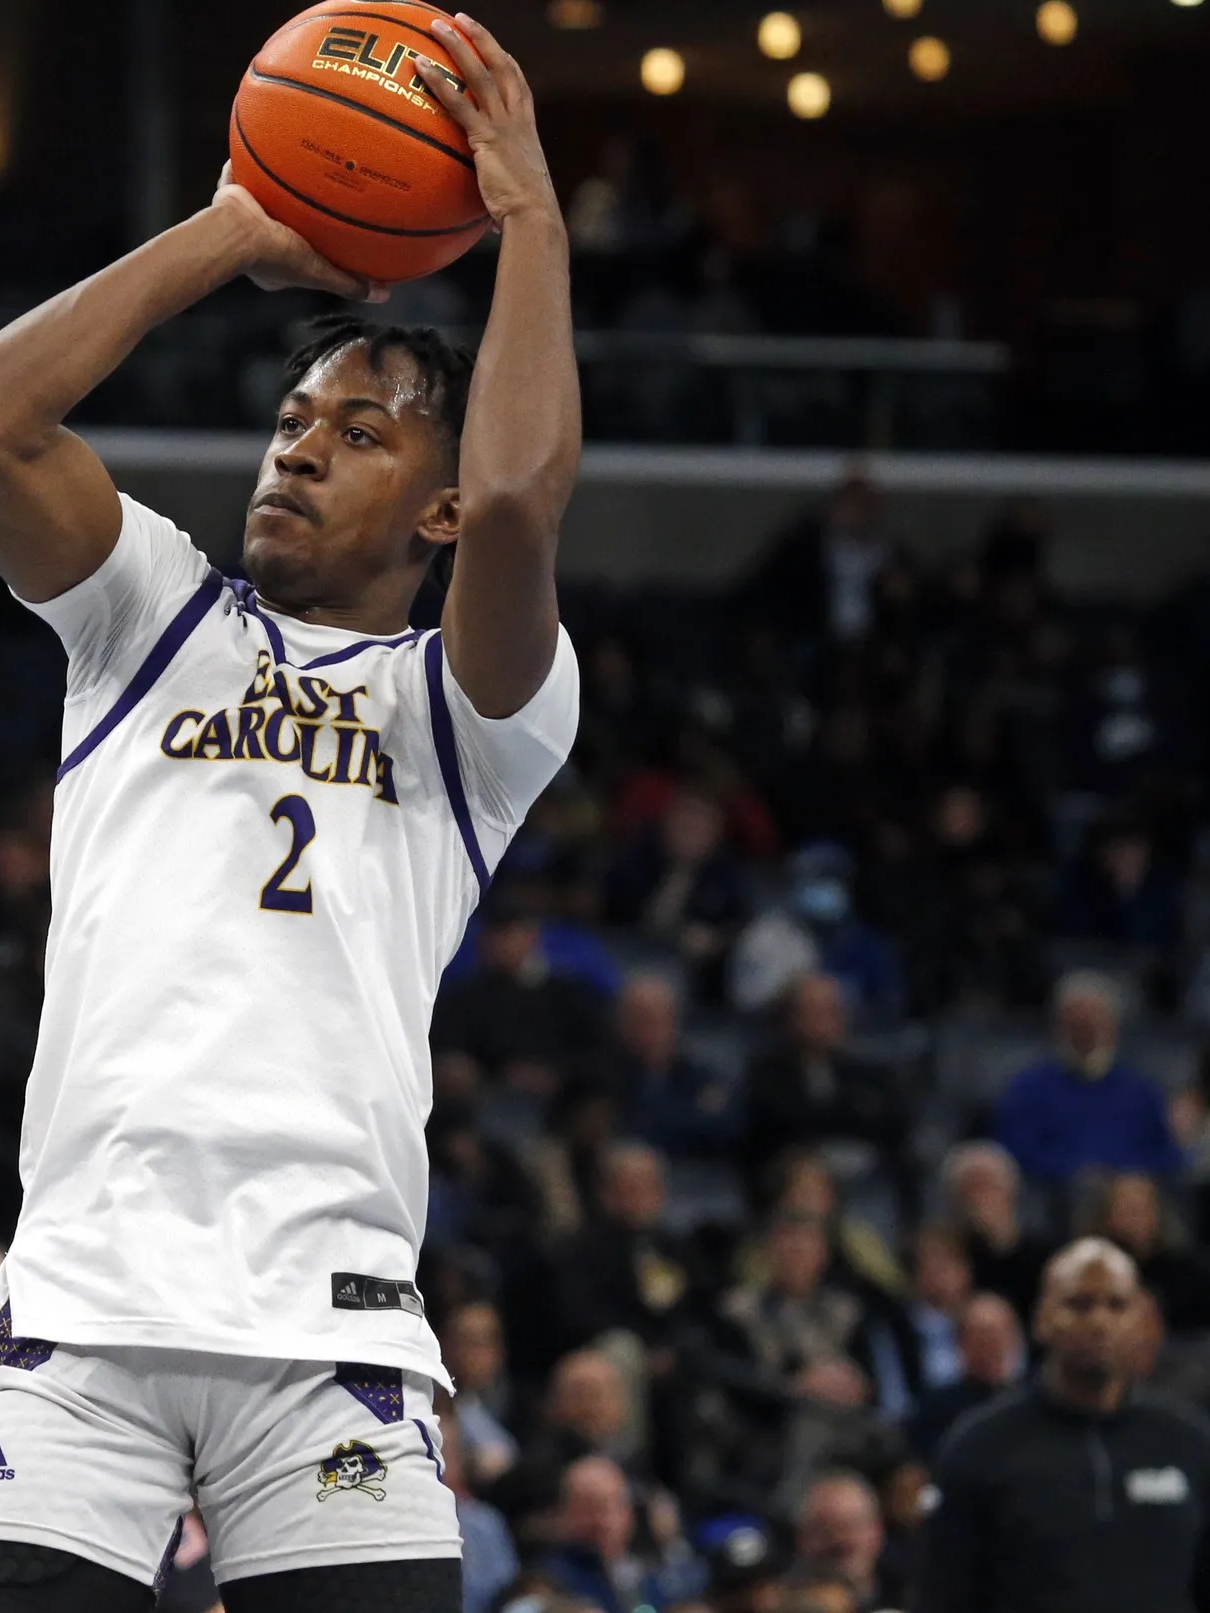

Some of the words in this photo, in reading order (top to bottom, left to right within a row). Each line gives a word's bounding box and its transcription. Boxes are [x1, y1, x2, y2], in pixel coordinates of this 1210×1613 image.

[311, 59, 439, 115] CHAMPIONSH
[243, 649, 369, 724] EAST
[160, 703, 400, 806] CAROLINA
[258, 792, 317, 915] 2
[376, 1292, 387, 1304] M
